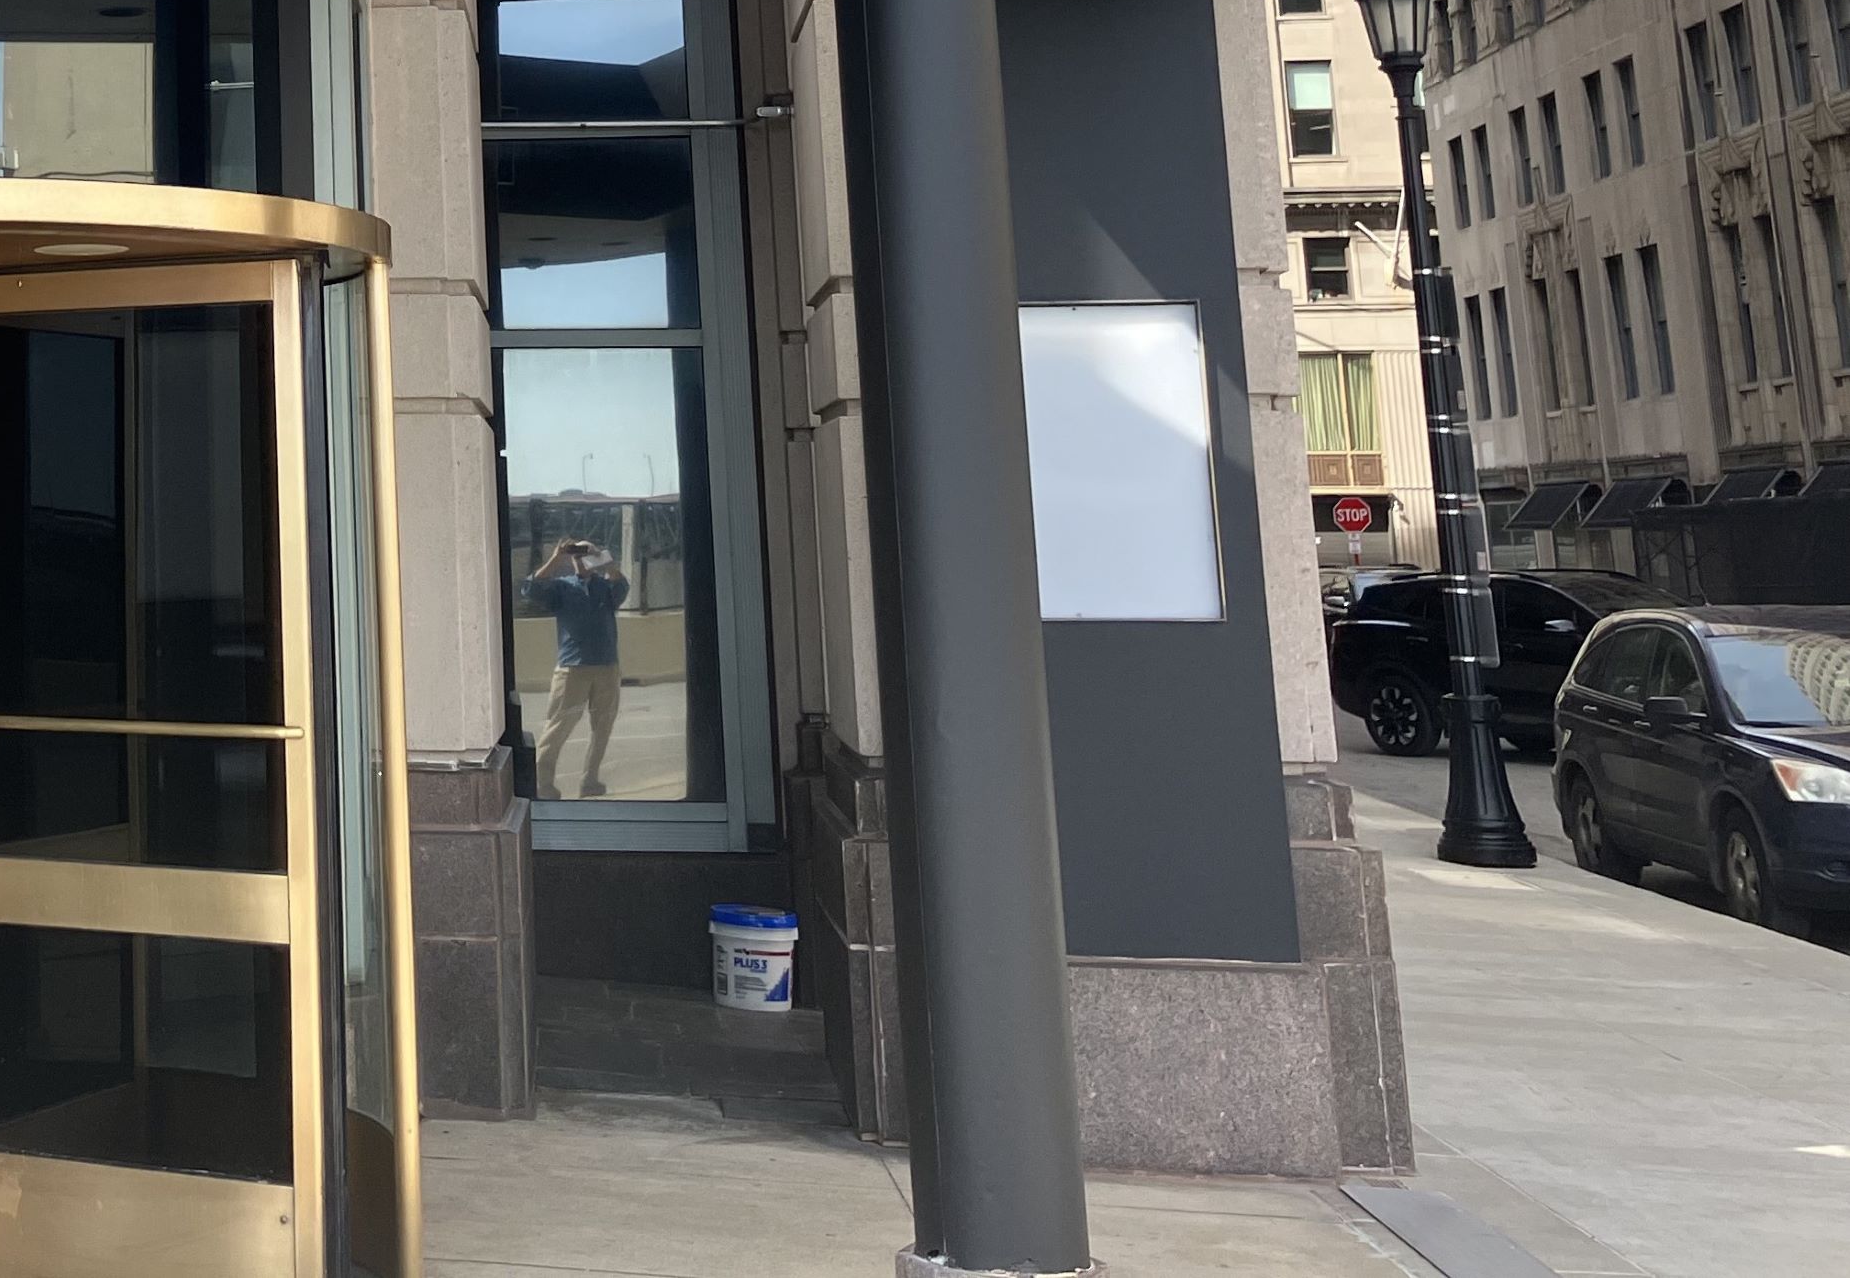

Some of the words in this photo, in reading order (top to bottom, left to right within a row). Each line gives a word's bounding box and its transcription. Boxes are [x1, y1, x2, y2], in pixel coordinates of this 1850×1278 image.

[1336, 508, 1368, 522] STOP
[734, 957, 760, 968] PLUS
[761, 959, 768, 969] 3
